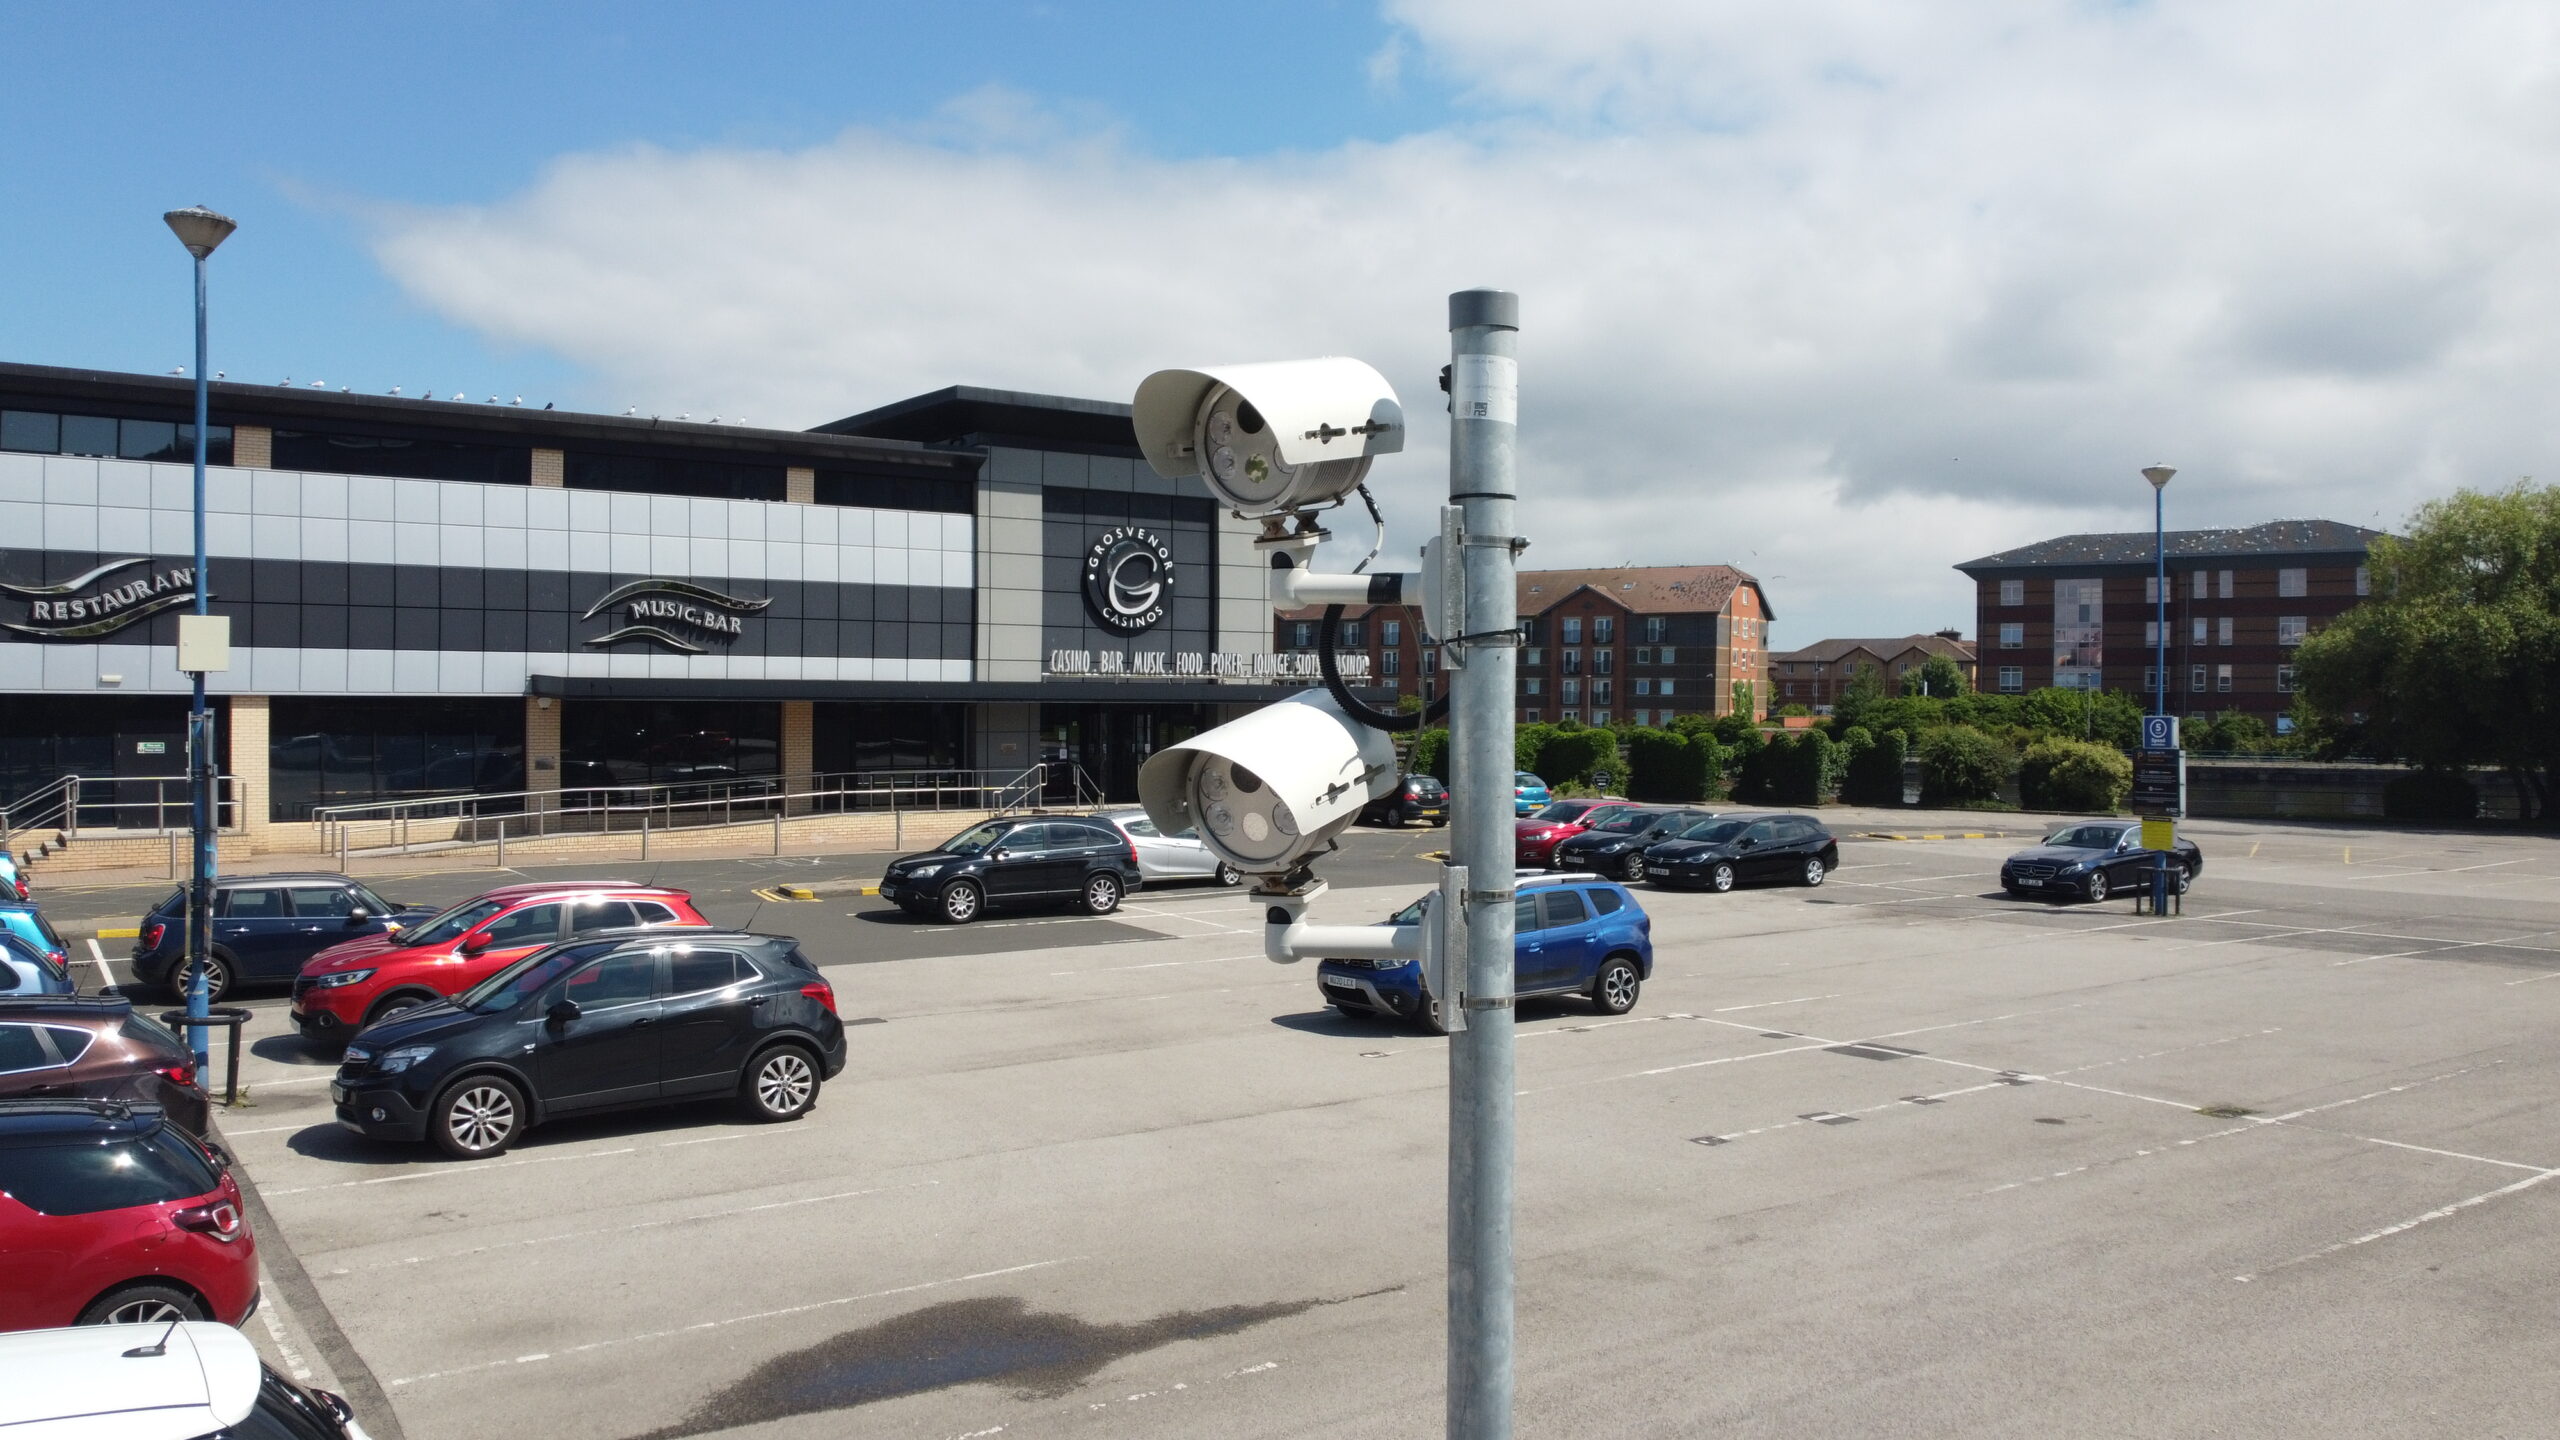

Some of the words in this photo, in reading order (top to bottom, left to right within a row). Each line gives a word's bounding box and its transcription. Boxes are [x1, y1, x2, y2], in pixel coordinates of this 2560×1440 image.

[1088, 526, 1173, 571] GROSVENOR
[33, 567, 207, 620] RESTAURAN
[1102, 606, 1164, 628] CASINOS
[1051, 649, 1091, 673] CASINO
[1101, 650, 1124, 673] BAR
[1132, 651, 1166, 674] MUSIC
[1176, 652, 1203, 674] FOOD
[1211, 652, 1243, 675] POKER
[1253, 653, 1289, 676] LOUNGE
[2155, 723, 2162, 731] 5
